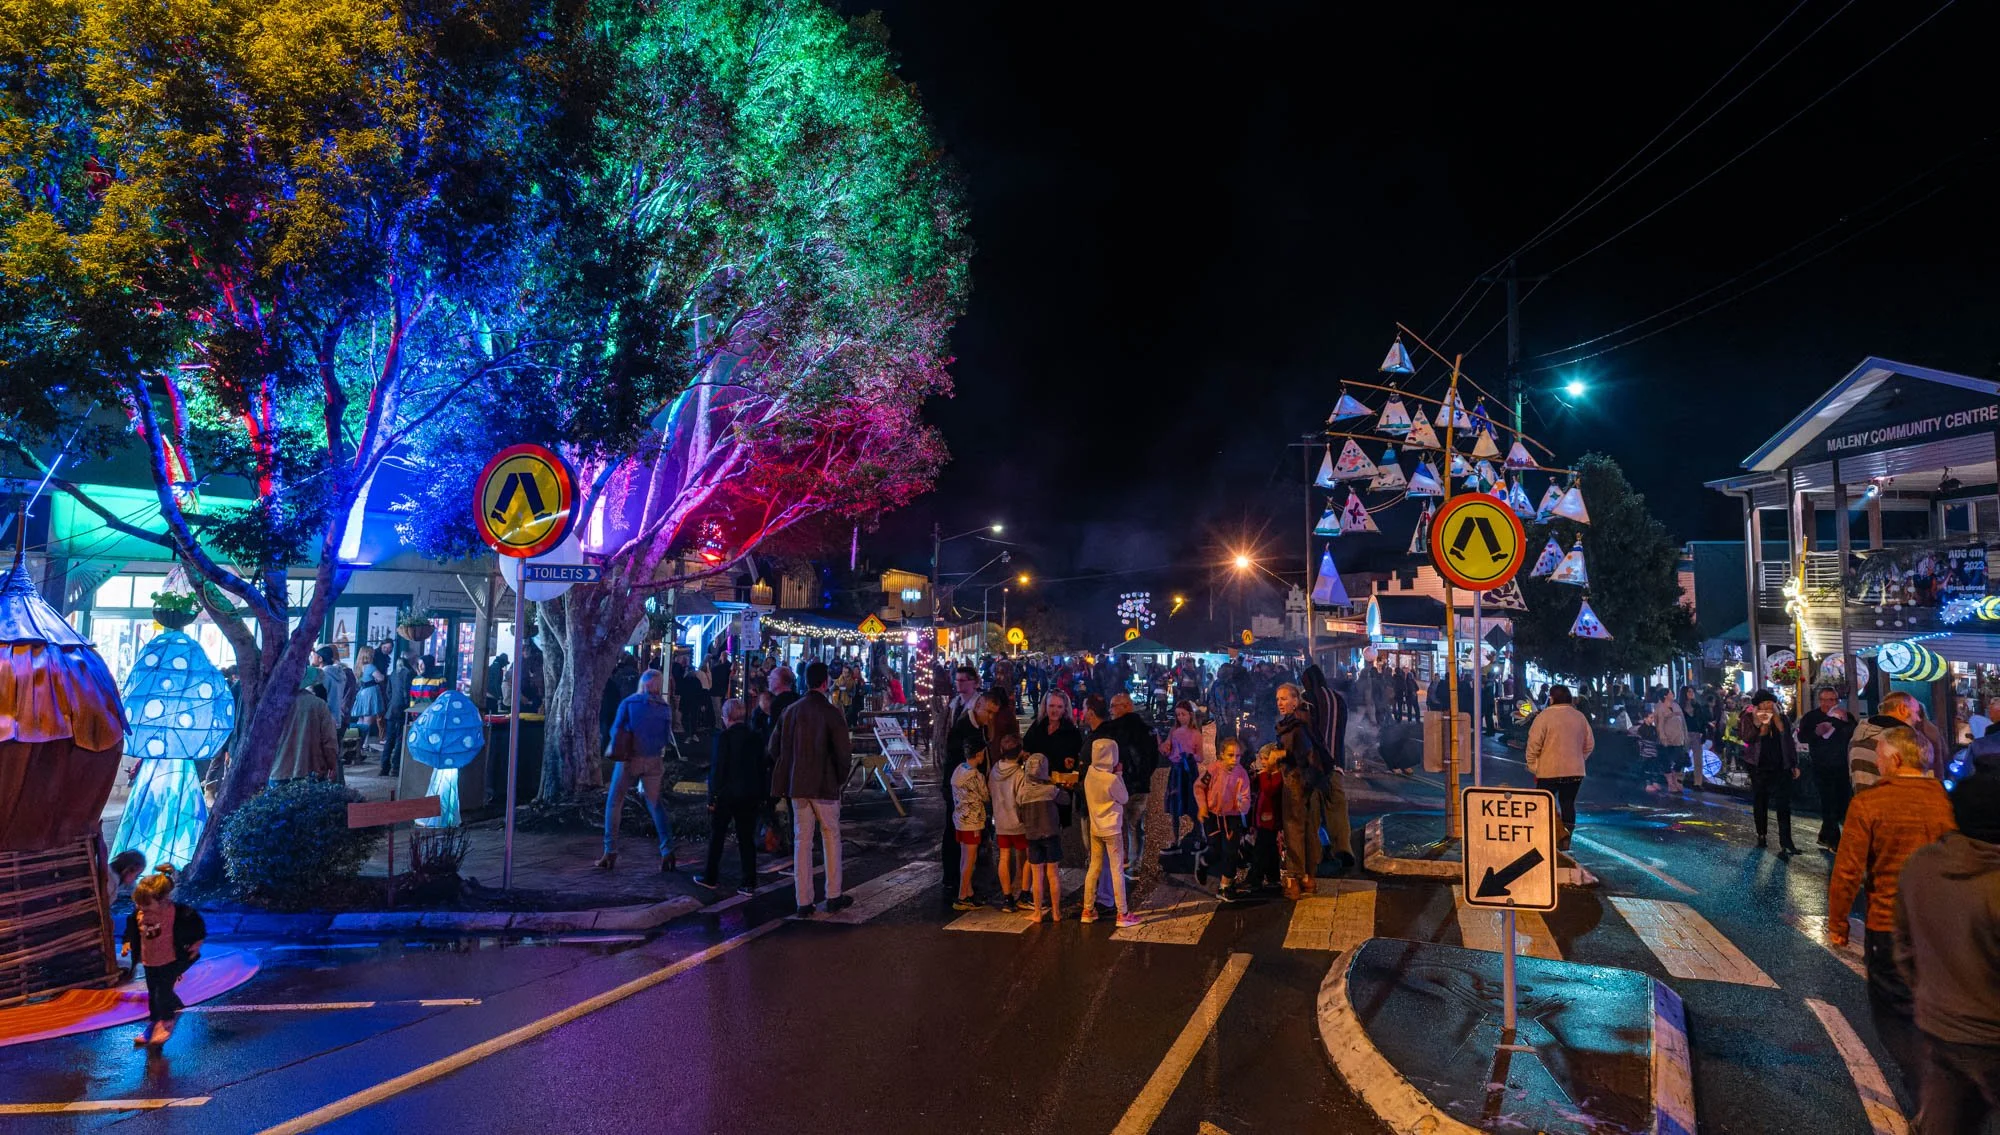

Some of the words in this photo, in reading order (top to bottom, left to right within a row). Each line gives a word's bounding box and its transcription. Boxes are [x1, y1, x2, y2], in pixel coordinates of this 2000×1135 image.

[1827, 431, 1868, 452] MALENY
[1870, 416, 1942, 444] COMMUNITY
[1945, 404, 1998, 429] CENTRE
[1948, 550, 1967, 559] AUG
[1969, 549, 1984, 558] 4TH
[1963, 561, 1985, 570] 2023
[534, 567, 584, 580] TOILETS
[743, 611, 758, 621] 2P
[1481, 799, 1538, 819] KEEP
[1485, 823, 1535, 843] LEFT
